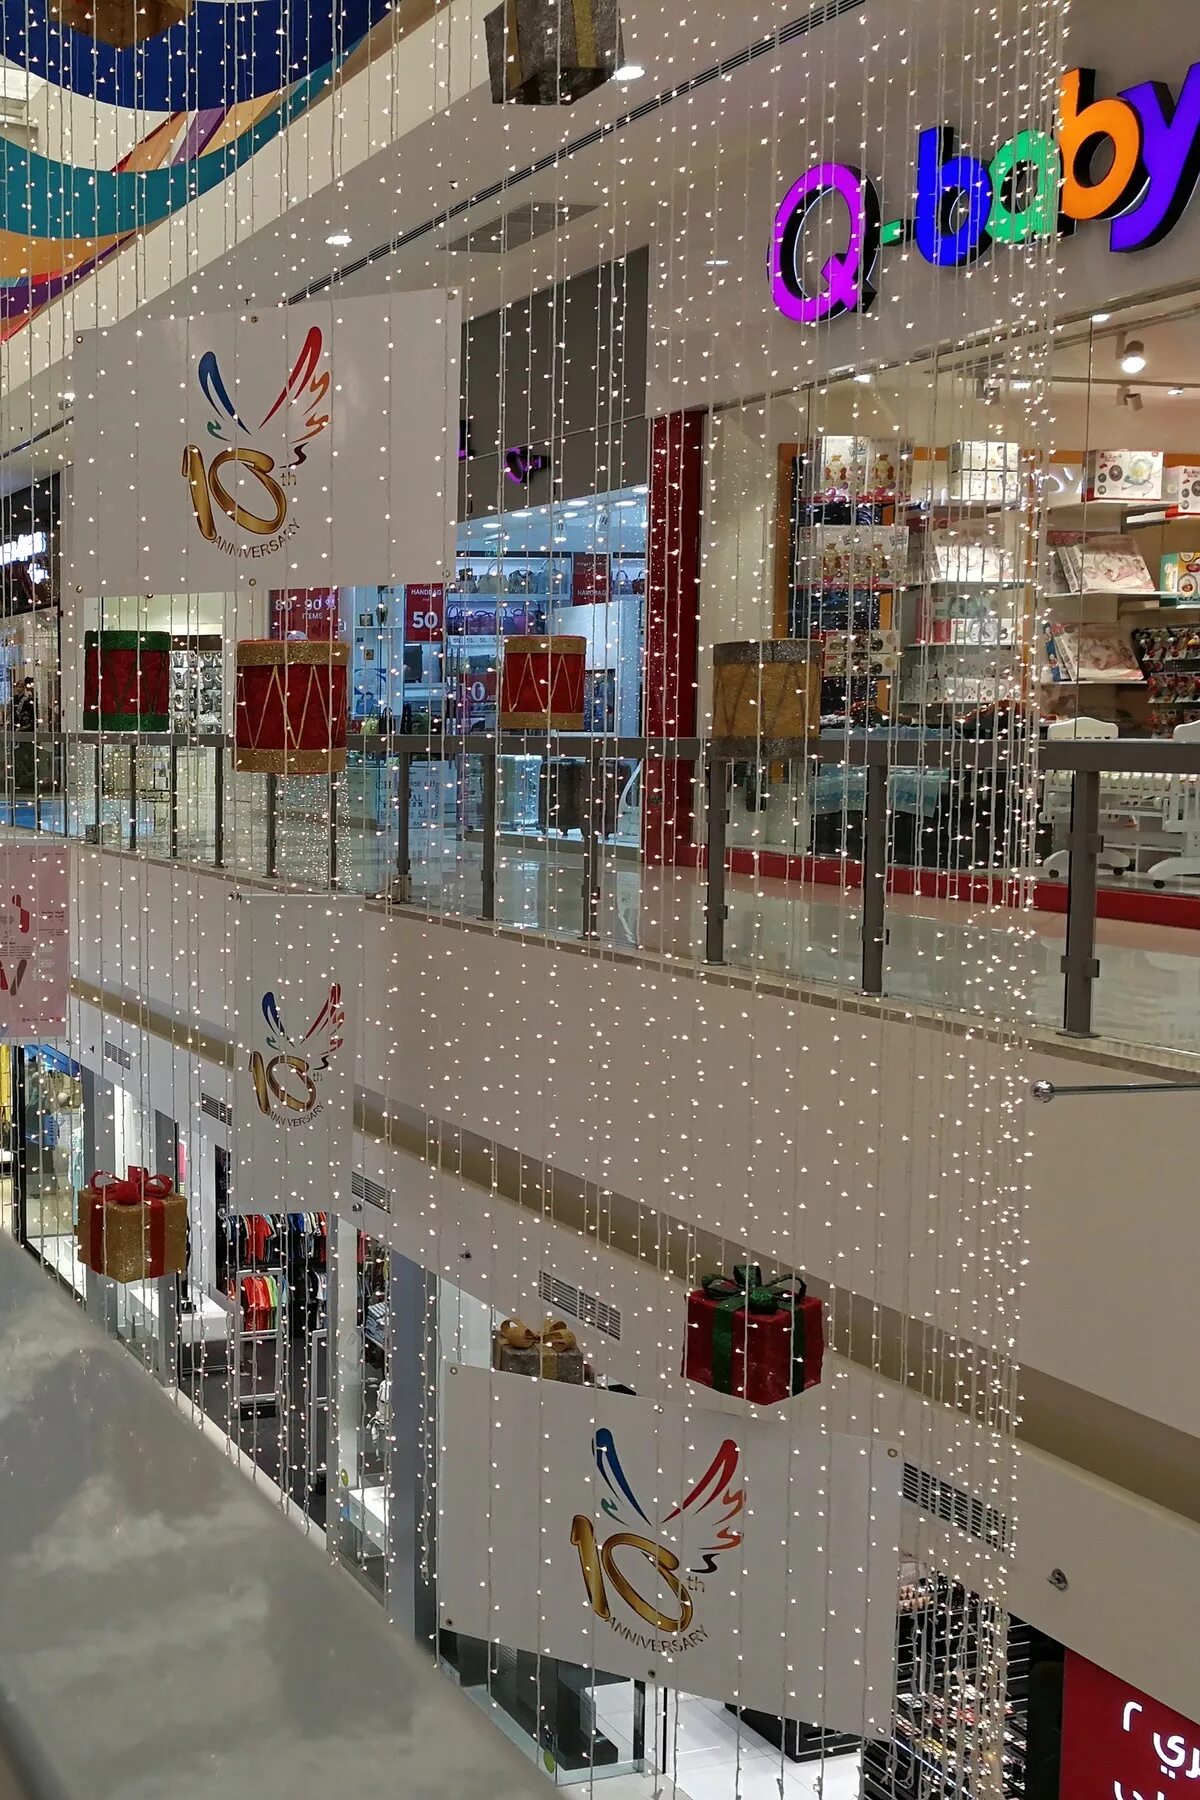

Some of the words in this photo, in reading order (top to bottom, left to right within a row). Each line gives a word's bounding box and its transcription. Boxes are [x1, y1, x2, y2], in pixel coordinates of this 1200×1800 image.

[767, 62, 1200, 324] Q-baby
[181, 444, 287, 542] 10
[210, 517, 301, 559] ANNIVERSARY
[412, 611, 438, 629] 50
[248, 1050, 317, 1114] 10
[570, 1514, 694, 1632] 10
[686, 1574, 706, 1593] th
[605, 1617, 710, 1653] ANNIVERSARY
